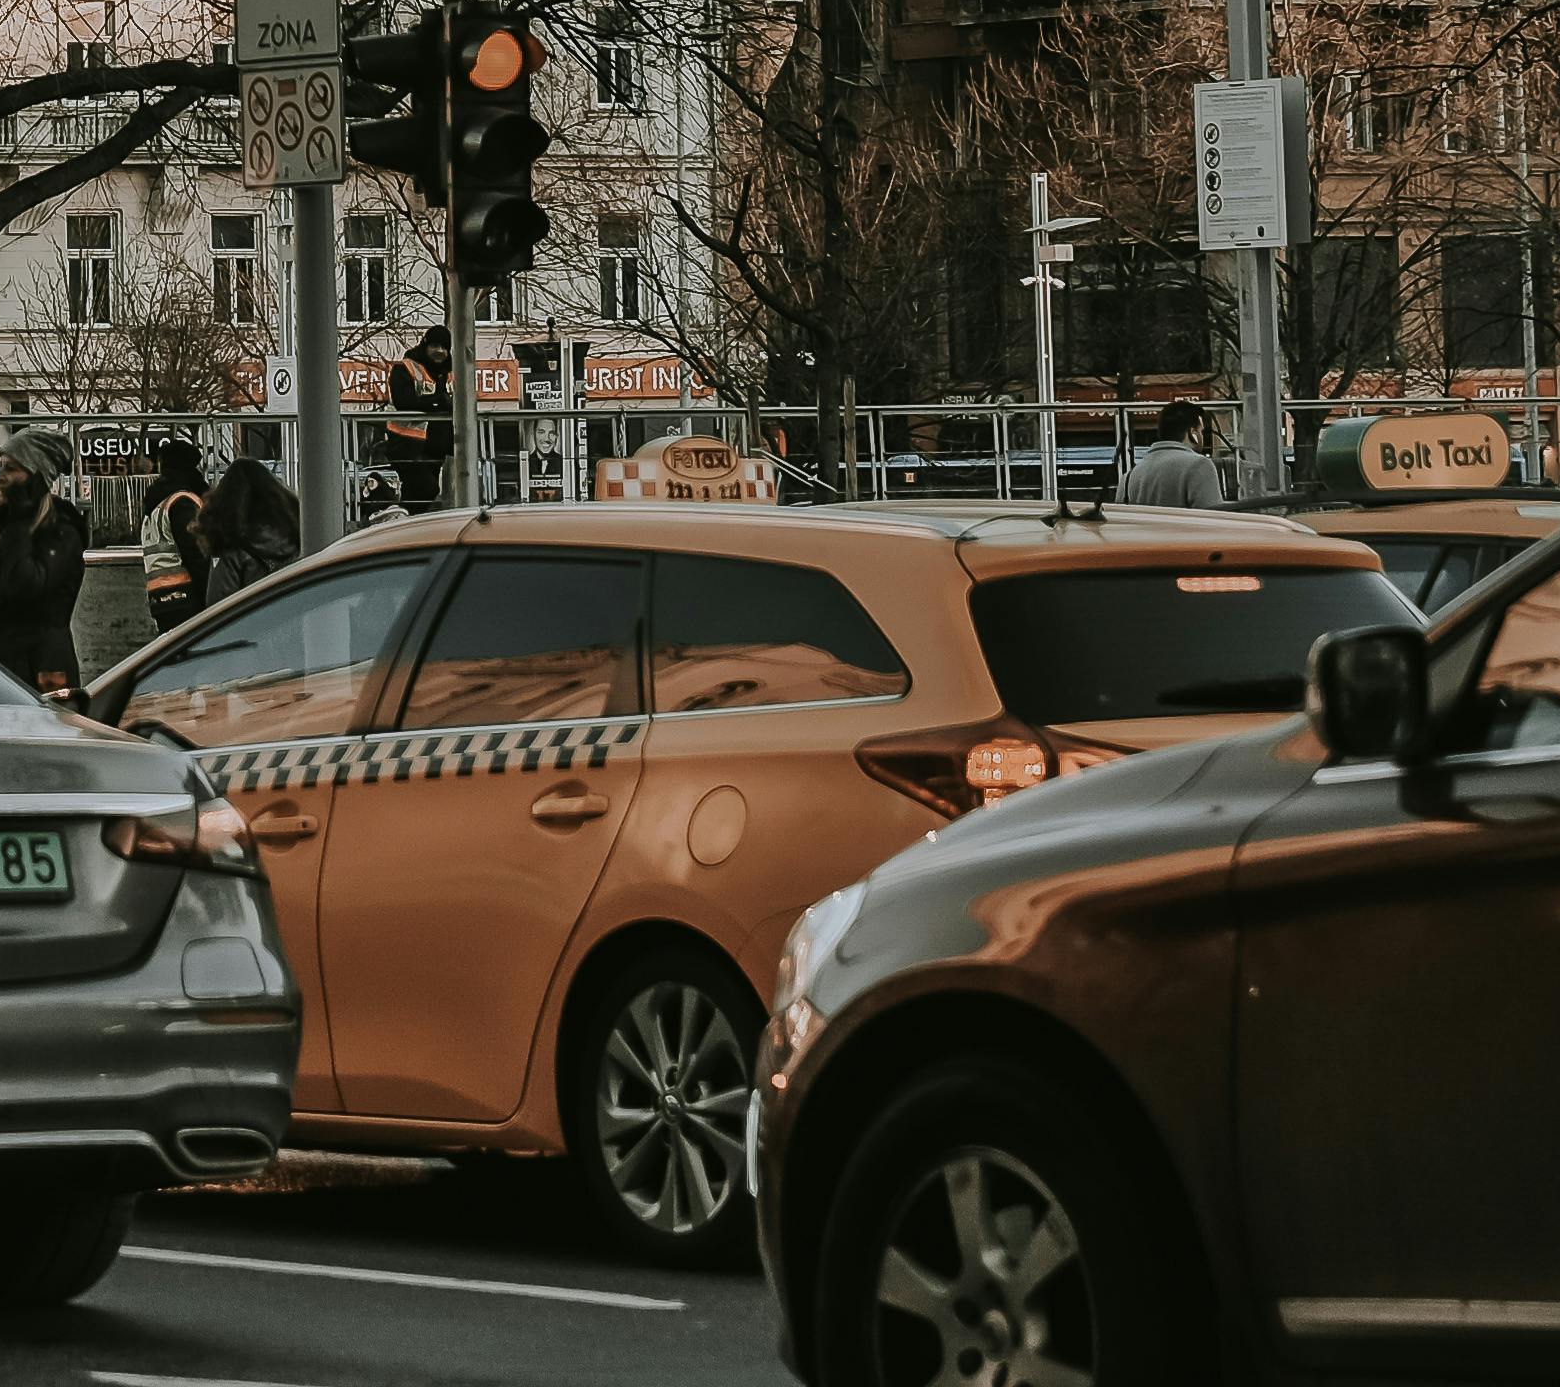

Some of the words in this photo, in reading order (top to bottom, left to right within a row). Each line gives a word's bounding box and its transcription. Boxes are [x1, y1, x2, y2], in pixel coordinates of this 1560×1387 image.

[583, 366, 644, 391] URIST
[1379, 440, 1432, 472] Bolt
[1436, 434, 1492, 468] Taxi
